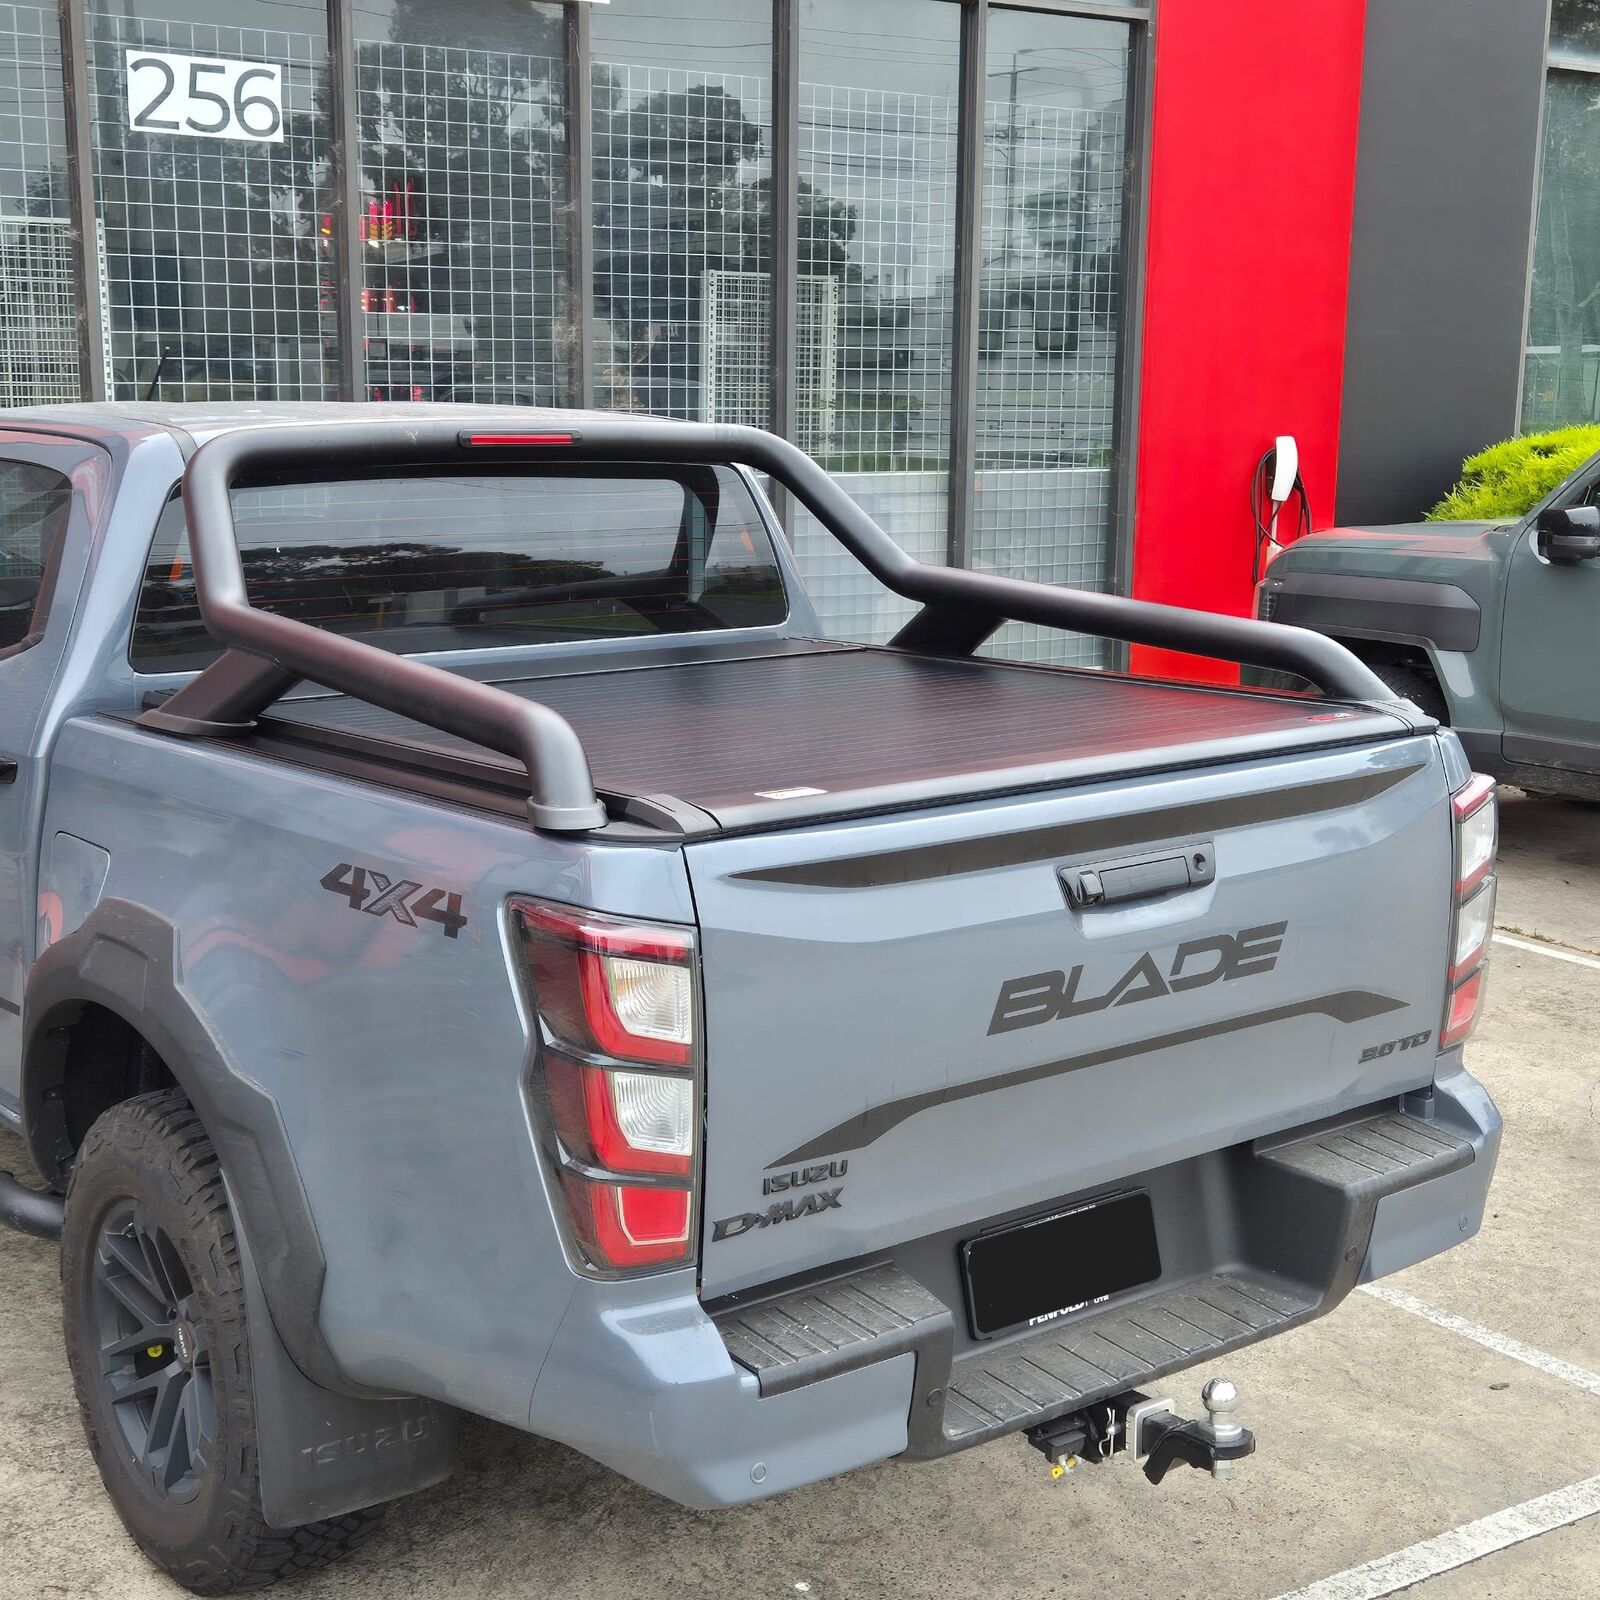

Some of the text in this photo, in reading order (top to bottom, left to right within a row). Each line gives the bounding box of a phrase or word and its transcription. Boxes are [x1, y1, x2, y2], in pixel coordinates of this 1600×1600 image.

[129, 57, 281, 138] 256
[986, 920, 1288, 1037] BLADE
[762, 1159, 849, 1196] ISUZU
